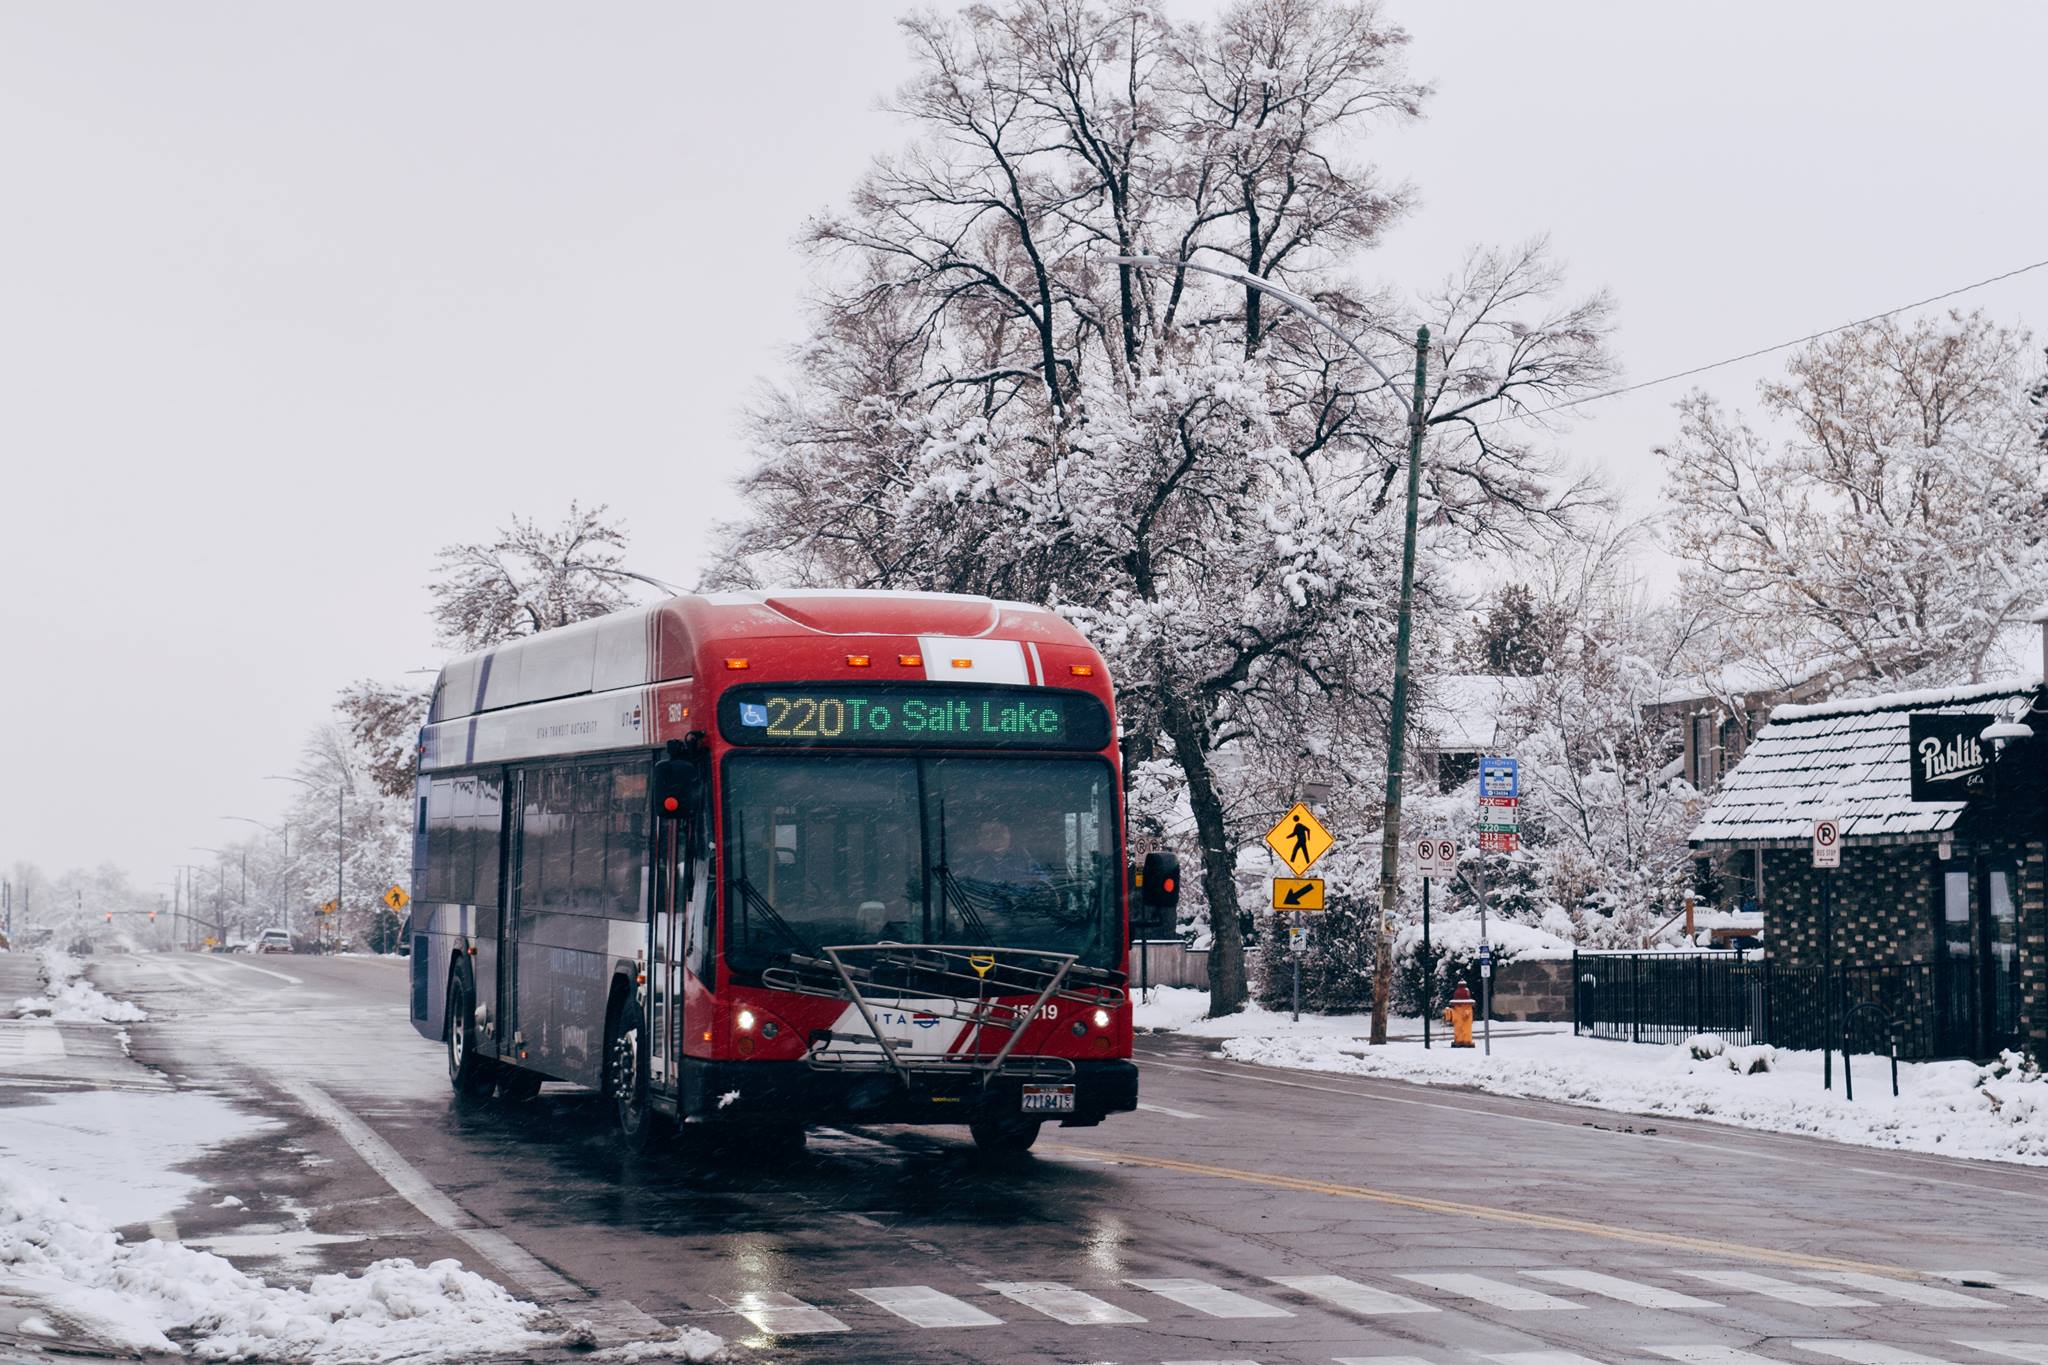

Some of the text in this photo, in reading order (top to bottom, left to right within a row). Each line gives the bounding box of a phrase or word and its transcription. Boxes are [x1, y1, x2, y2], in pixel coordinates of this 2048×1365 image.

[766, 697, 1059, 736] 220 To Salt Lake
[1484, 806, 1489, 815] 3
[1483, 815, 1489, 823] 9
[1483, 824, 1499, 832] 220
[1484, 833, 1498, 841] 313
[1484, 841, 1499, 849] 354
